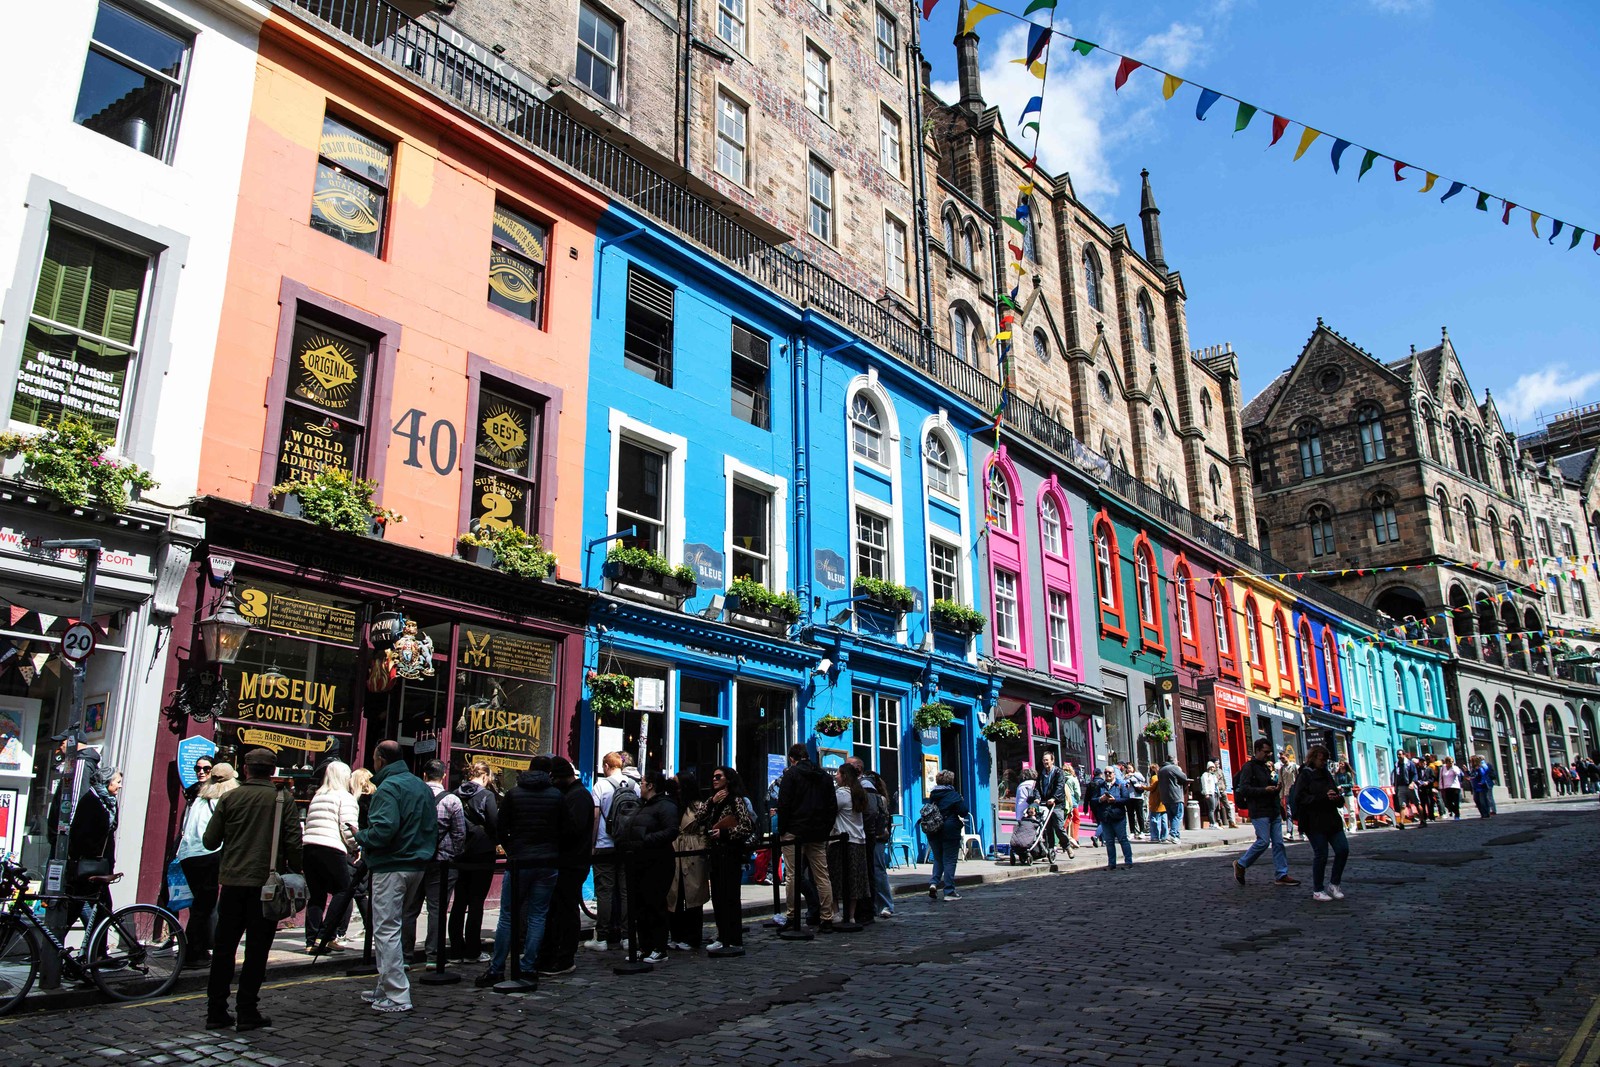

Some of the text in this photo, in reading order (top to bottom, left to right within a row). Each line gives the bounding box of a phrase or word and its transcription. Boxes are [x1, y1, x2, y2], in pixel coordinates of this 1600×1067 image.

[347, 142, 364, 155] OUR
[366, 147, 386, 163] SHOP
[328, 180, 368, 201] QUALITY
[516, 229, 528, 243] OUR
[526, 241, 540, 258] SHOP
[507, 259, 534, 278] UNIQUE
[37, 352, 114, 383] Over 150 Artists!
[308, 354, 350, 380] ORIGINAL
[17, 370, 120, 407] Ceramics, Homeware
[26, 360, 120, 397] Art Prints, Jewellery,
[17, 382, 60, 402] Creative
[60, 394, 84, 410] Gifts
[84, 402, 92, 412] &
[92, 403, 120, 420] Cards
[291, 429, 344, 453] WORLD
[392, 408, 458, 476] 40
[492, 422, 519, 442] BEST
[285, 440, 348, 467] FAMOUS!
[281, 452, 350, 480] ADMISSN
[480, 492, 513, 533] 2
[699, 564, 722, 581] BLEUE
[827, 571, 845, 585] BLEUE
[239, 588, 268, 618] 3
[274, 598, 284, 606] The
[285, 601, 308, 610] original
[308, 604, 319, 612] and
[271, 618, 285, 627] good
[286, 619, 293, 627] of
[303, 611, 326, 621] HARRY
[329, 615, 355, 626] POTTER
[317, 619, 326, 627] the
[328, 622, 342, 631] great
[344, 625, 355, 633] and
[66, 633, 92, 652] 20
[239, 671, 337, 713] MUSEUM
[255, 703, 316, 725] CONTEXT
[760, 707, 765, 717] B
[1258, 703, 1268, 713] THE
[469, 707, 541, 740] MUSEUM
[264, 732, 284, 743] HARRY
[285, 736, 307, 748] POTTER
[482, 734, 527, 751] CONTEXT
[923, 729, 938, 740] BLEUE
[502, 759, 519, 768] POTTER
